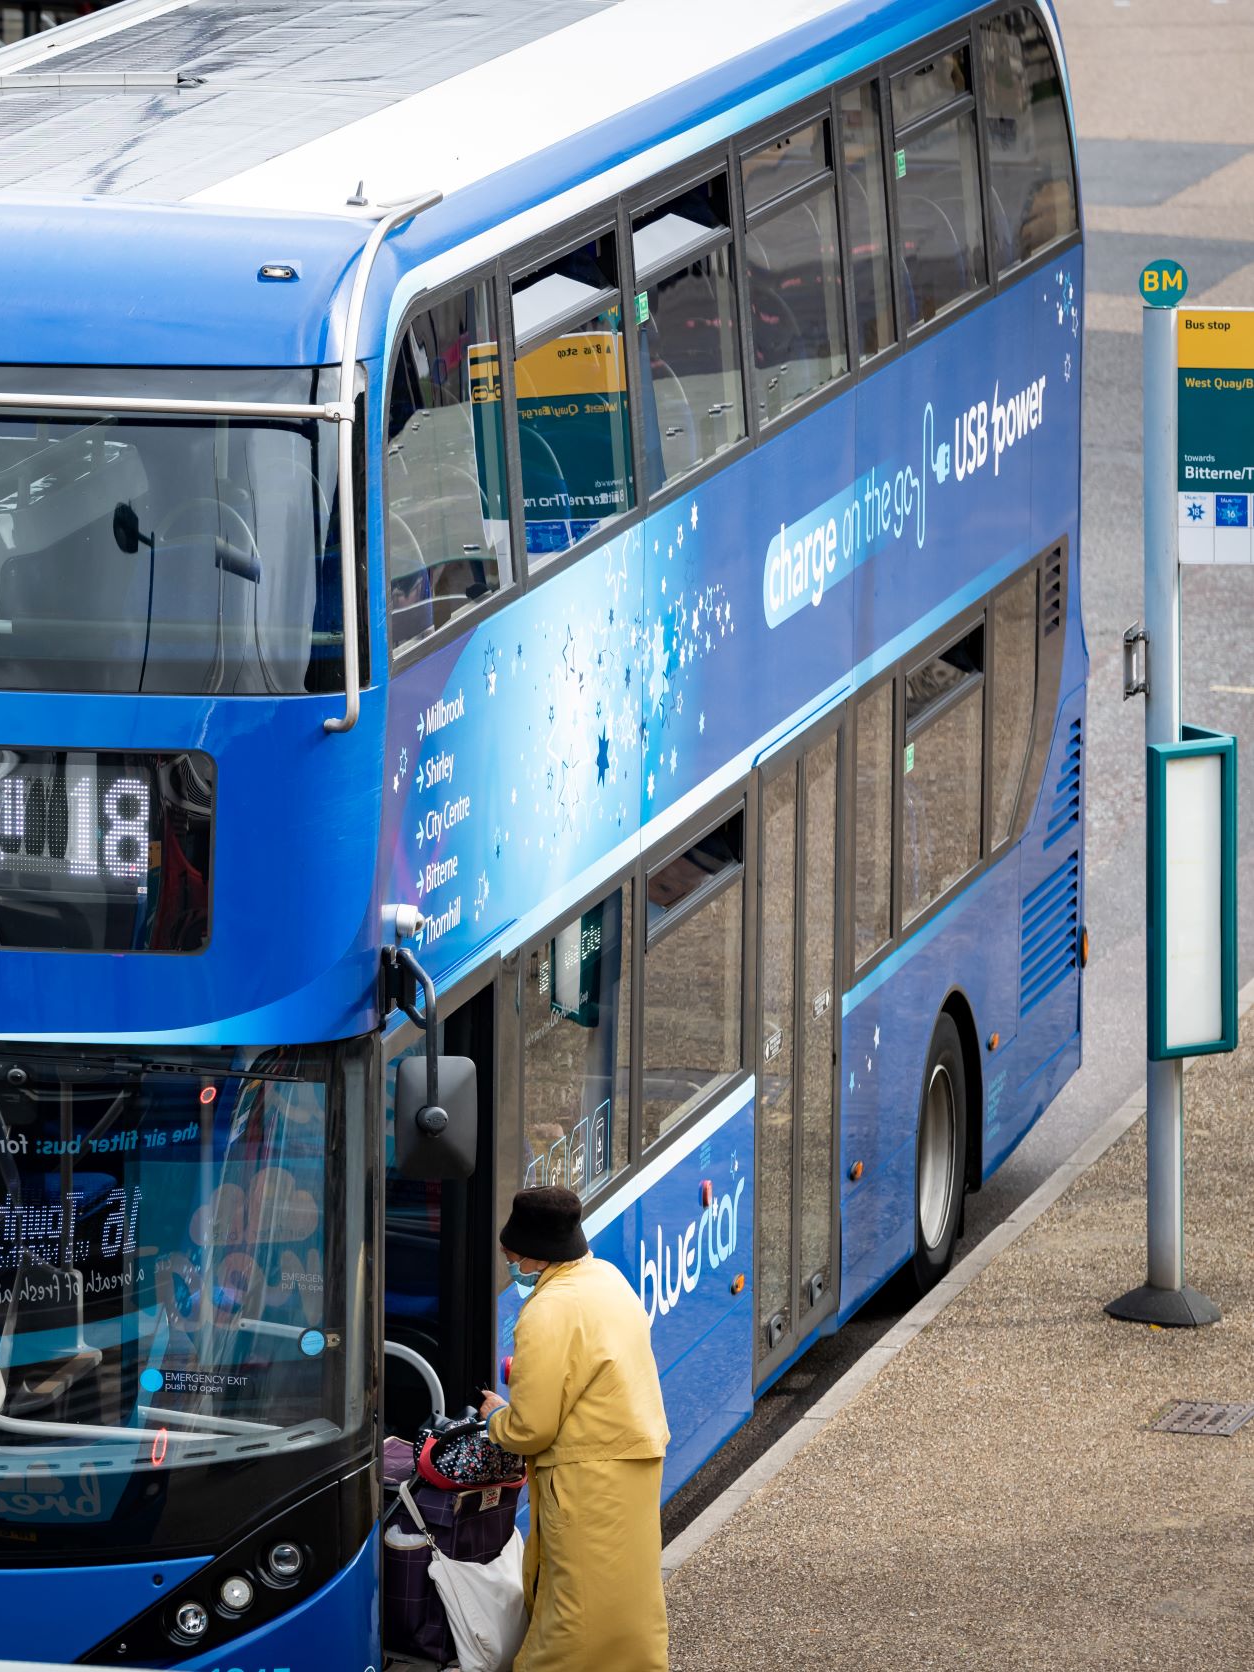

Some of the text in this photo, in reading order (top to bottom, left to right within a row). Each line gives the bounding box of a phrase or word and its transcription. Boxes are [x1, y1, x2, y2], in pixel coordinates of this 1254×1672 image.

[1143, 269, 1183, 292] BM
[1185, 319, 1231, 332] Bus stop
[1185, 377, 1212, 388] West
[955, 375, 1046, 481] USB power
[1184, 454, 1216, 462] towards
[1185, 466, 1254, 480] Bitterne/T
[1192, 508, 1200, 516] 18
[1227, 510, 1236, 518] 16
[769, 518, 837, 607] charge
[843, 500, 860, 559] on
[864, 467, 891, 542] the
[426, 688, 465, 737] Millbrook
[426, 751, 454, 788] Shirley
[69, 777, 150, 877] 18
[426, 796, 470, 842] City Centre
[426, 855, 458, 894] Bitterne
[425, 896, 461, 944] Thornhill
[640, 1177, 744, 1329] bluestar
[165, 1371, 248, 1386] EMERGENCY EXIT
[165, 1382, 223, 1395] push to open
